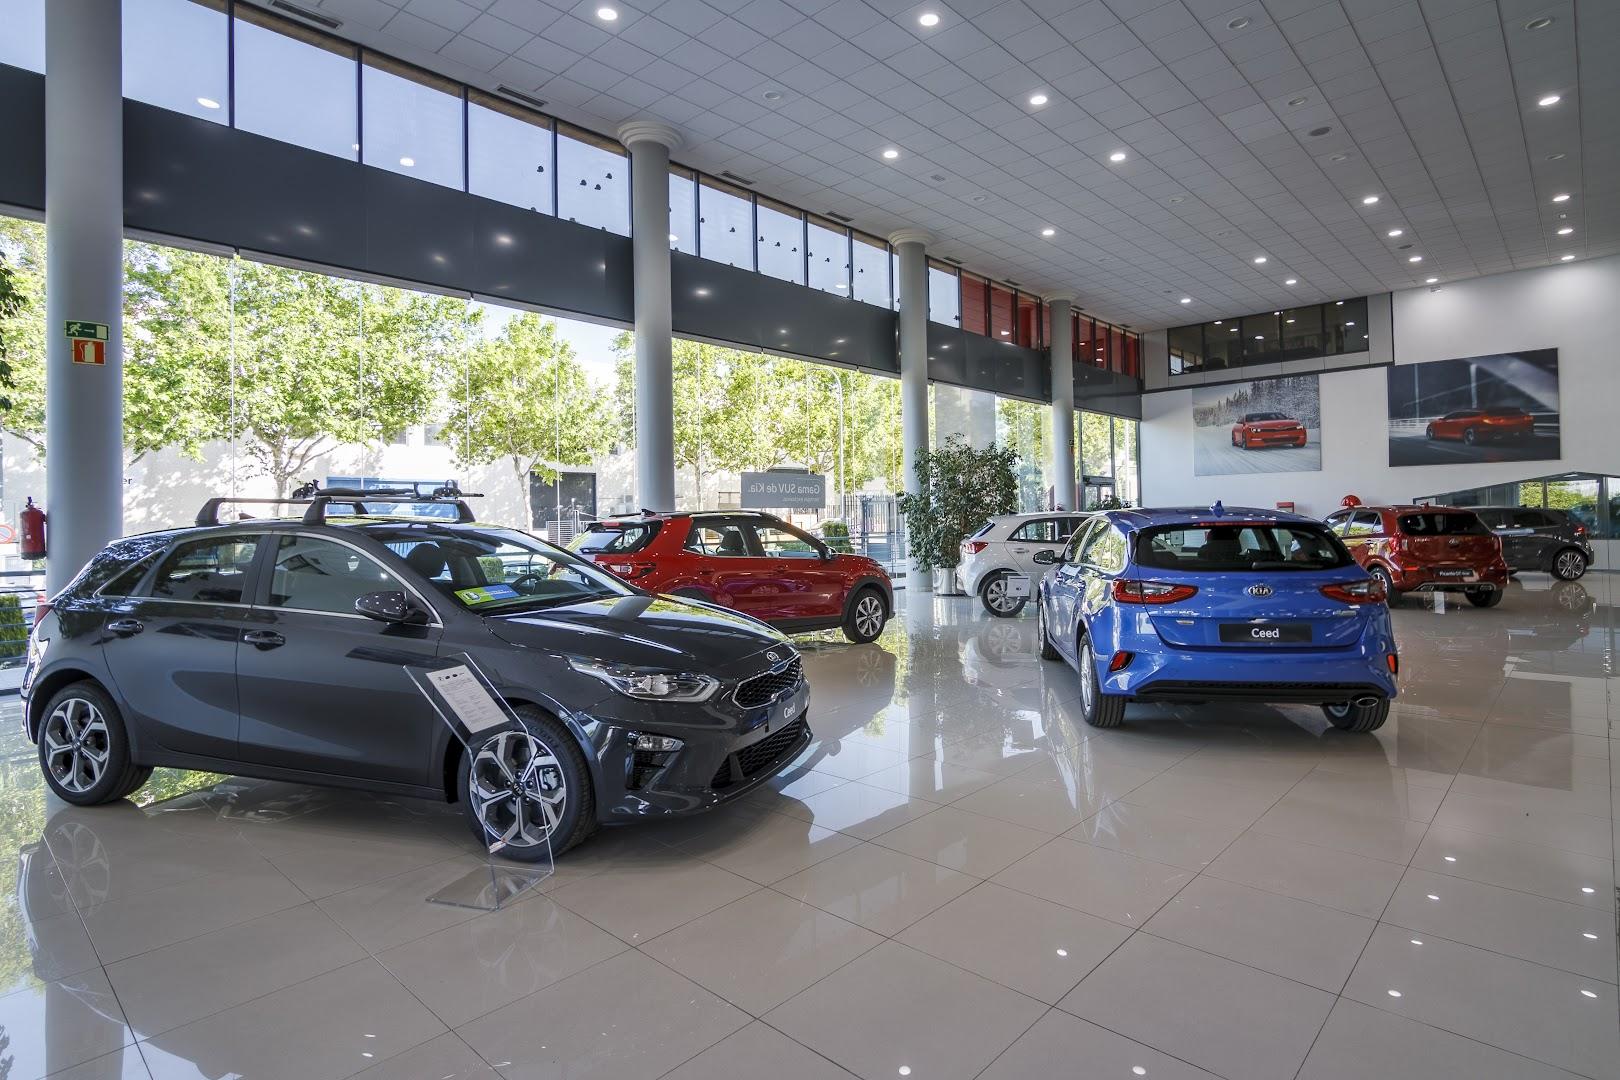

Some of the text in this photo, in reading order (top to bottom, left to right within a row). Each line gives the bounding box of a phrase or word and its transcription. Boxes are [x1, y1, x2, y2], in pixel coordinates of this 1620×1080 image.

[1252, 587, 1269, 595] KIA
[1251, 628, 1280, 638] Ceed
[783, 702, 796, 719] Ceed
